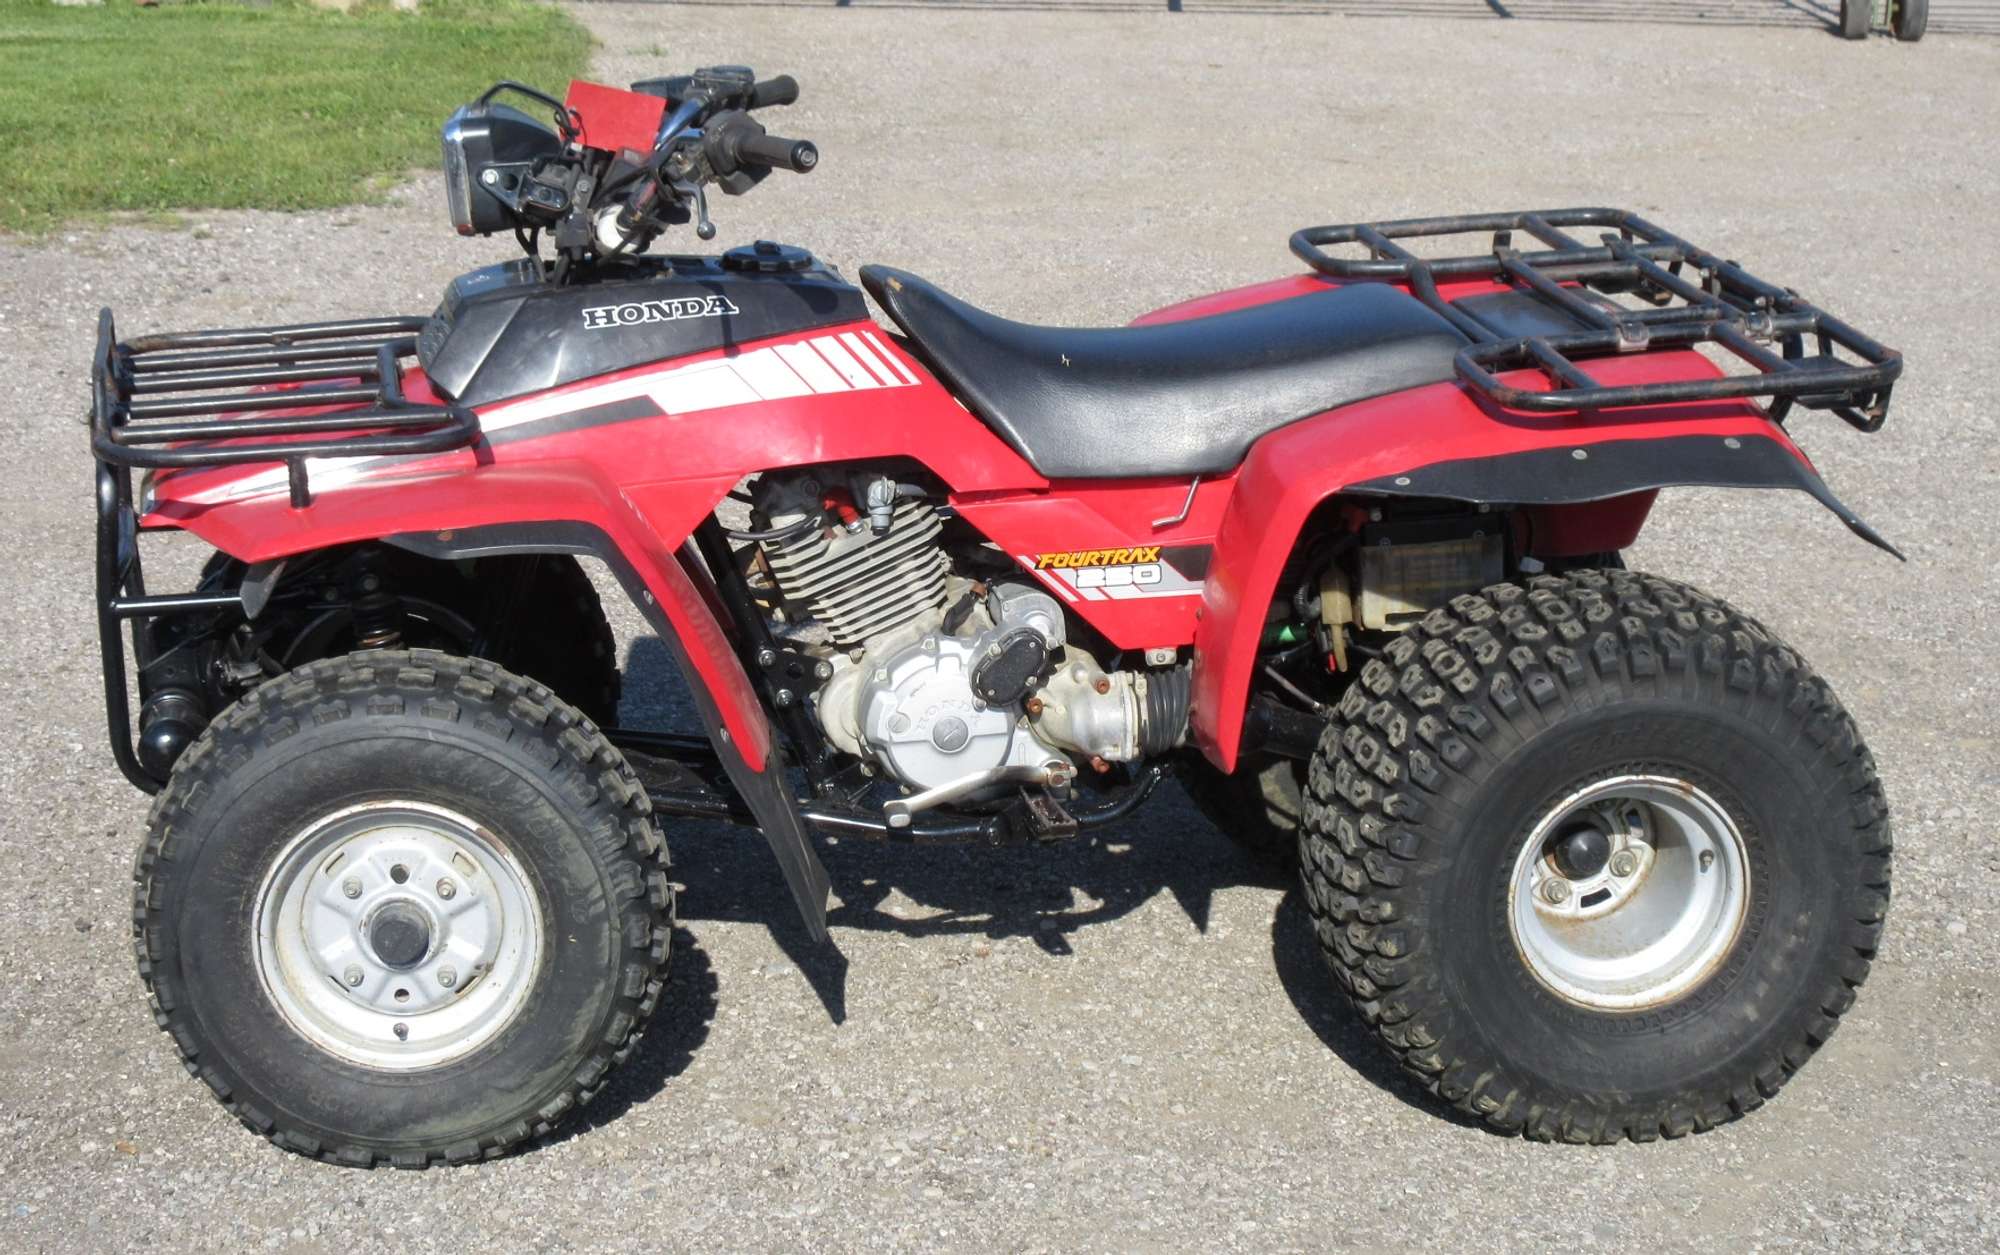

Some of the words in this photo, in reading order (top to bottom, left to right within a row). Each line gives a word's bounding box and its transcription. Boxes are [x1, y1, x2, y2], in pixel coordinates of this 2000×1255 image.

[582, 295, 739, 329] HONDA
[1037, 546, 1161, 569] FOURTRAX
[1076, 564, 1162, 588] 250
